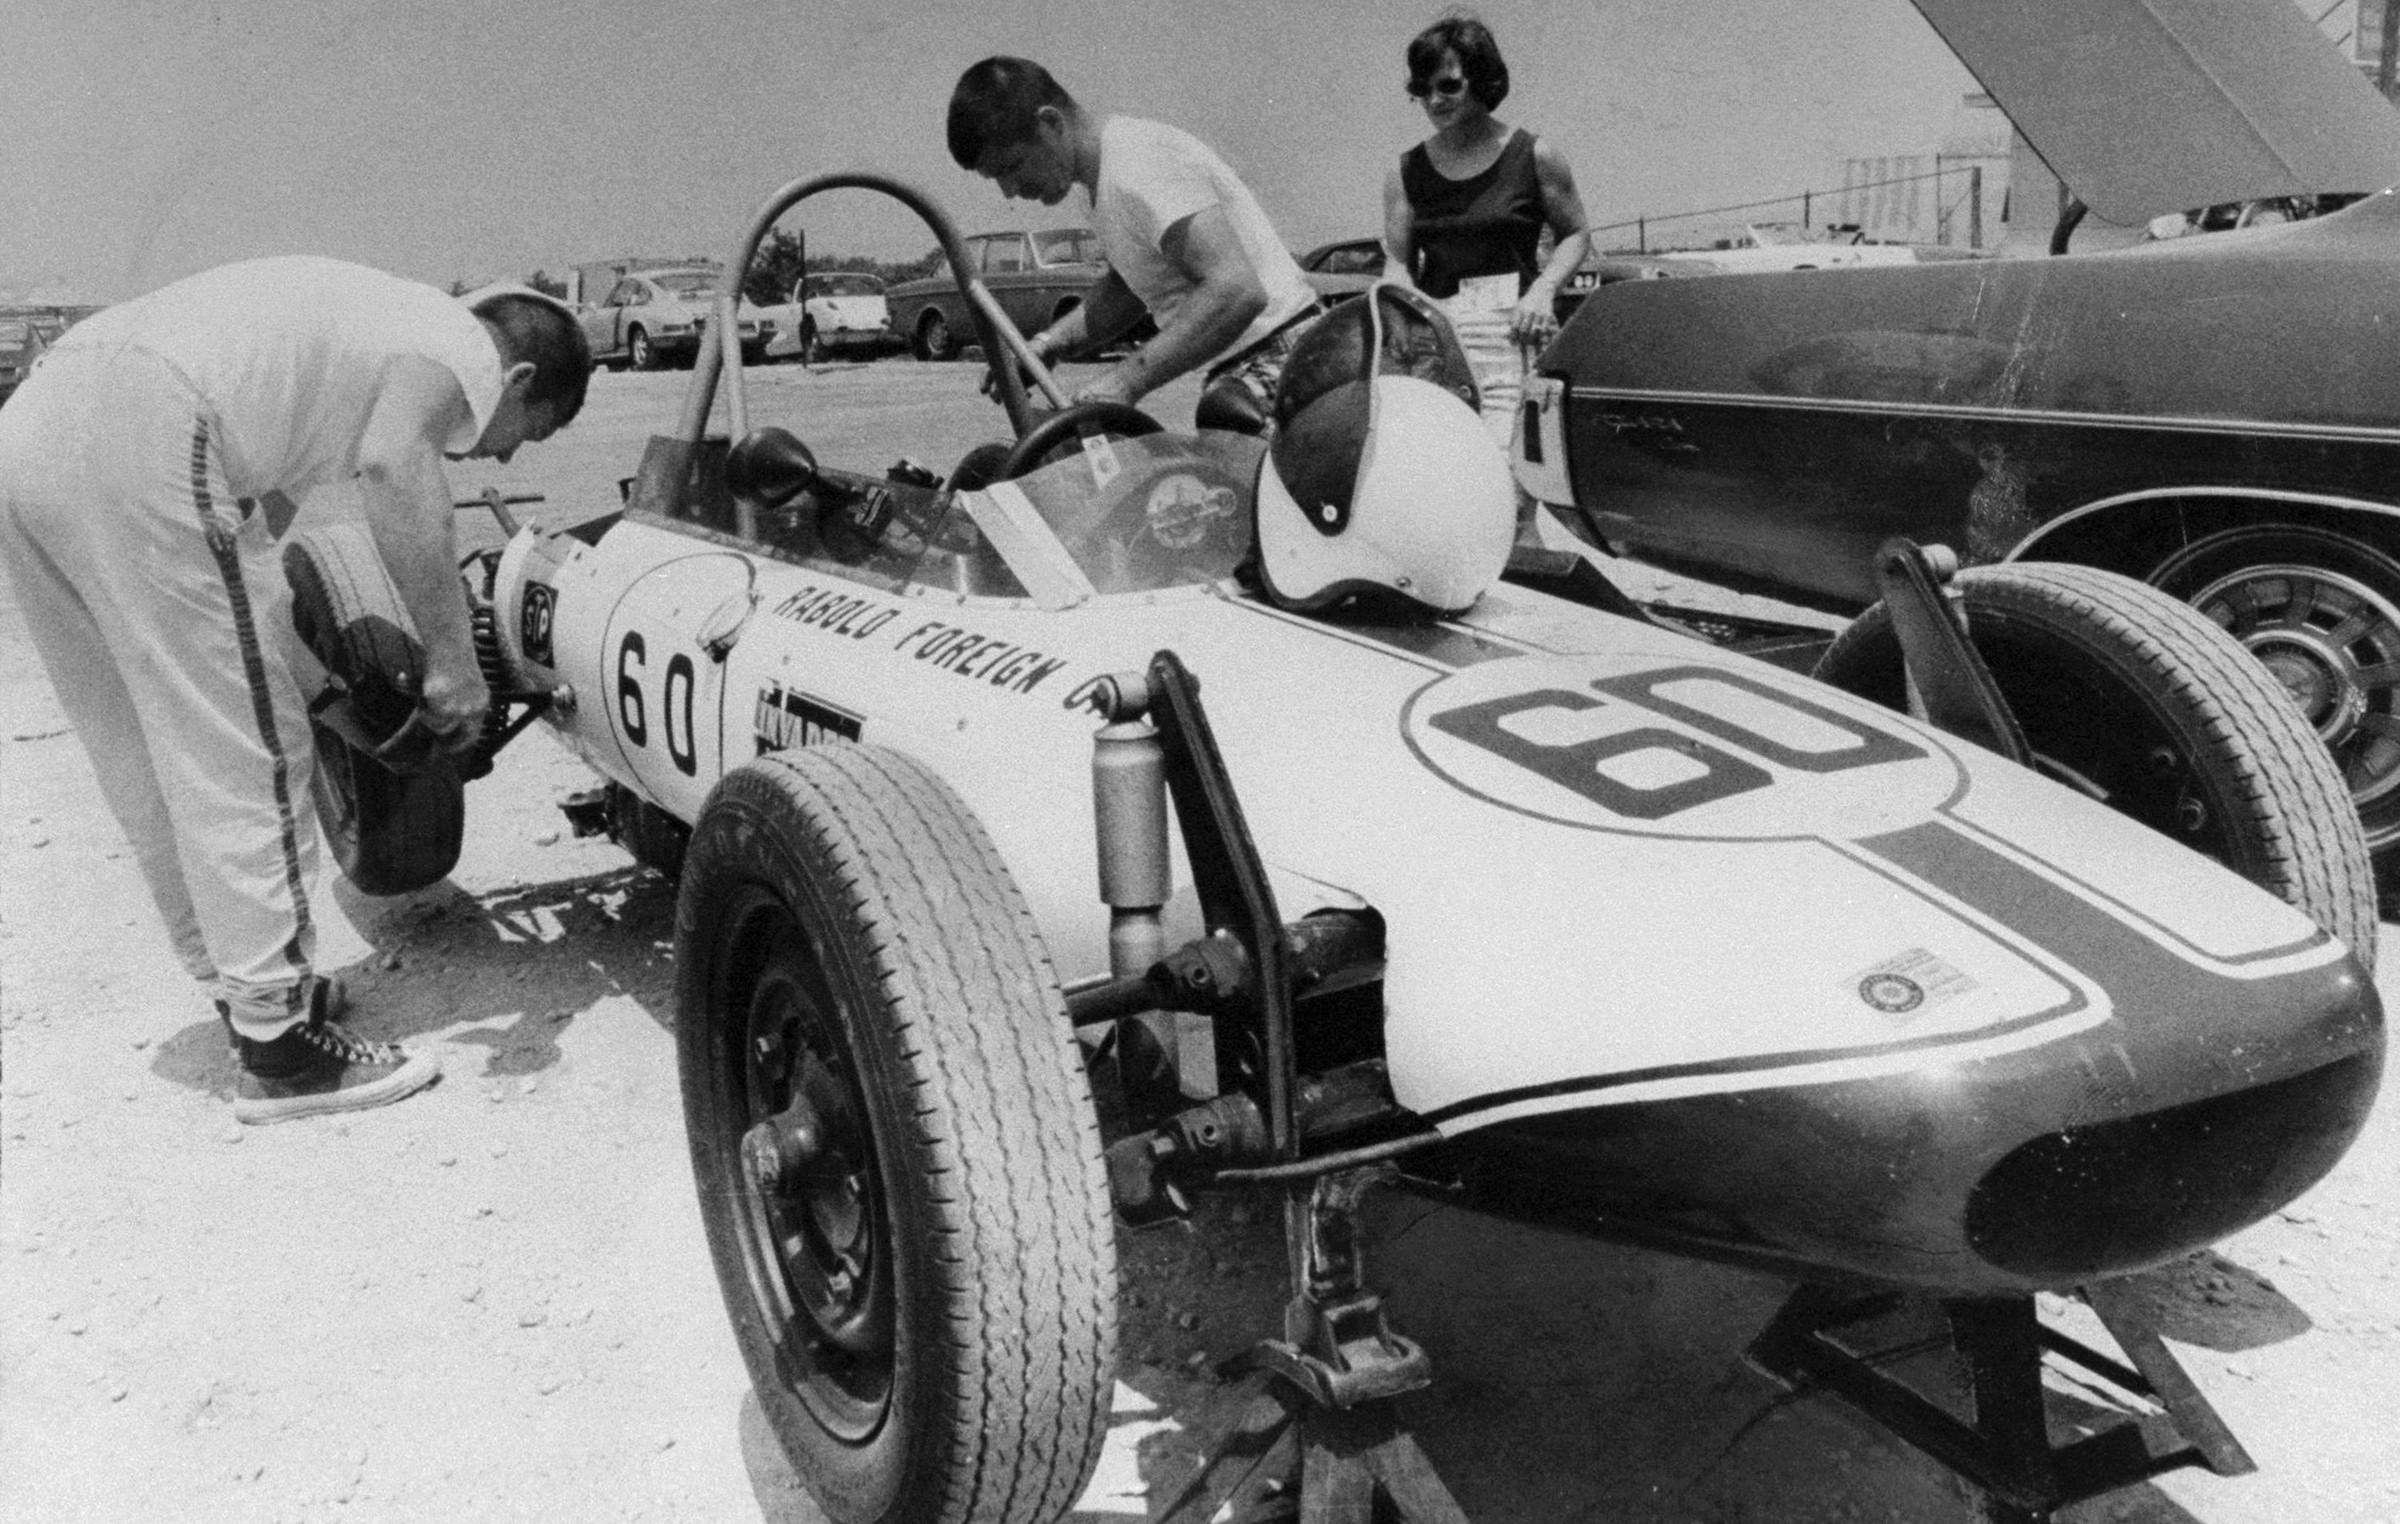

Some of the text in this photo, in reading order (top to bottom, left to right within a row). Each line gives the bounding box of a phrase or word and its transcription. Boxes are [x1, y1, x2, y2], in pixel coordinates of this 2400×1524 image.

[525, 593, 549, 644] STP
[894, 621, 1068, 694] FOREIGN
[618, 630, 697, 778] 60
[1428, 665, 1930, 820] 60
